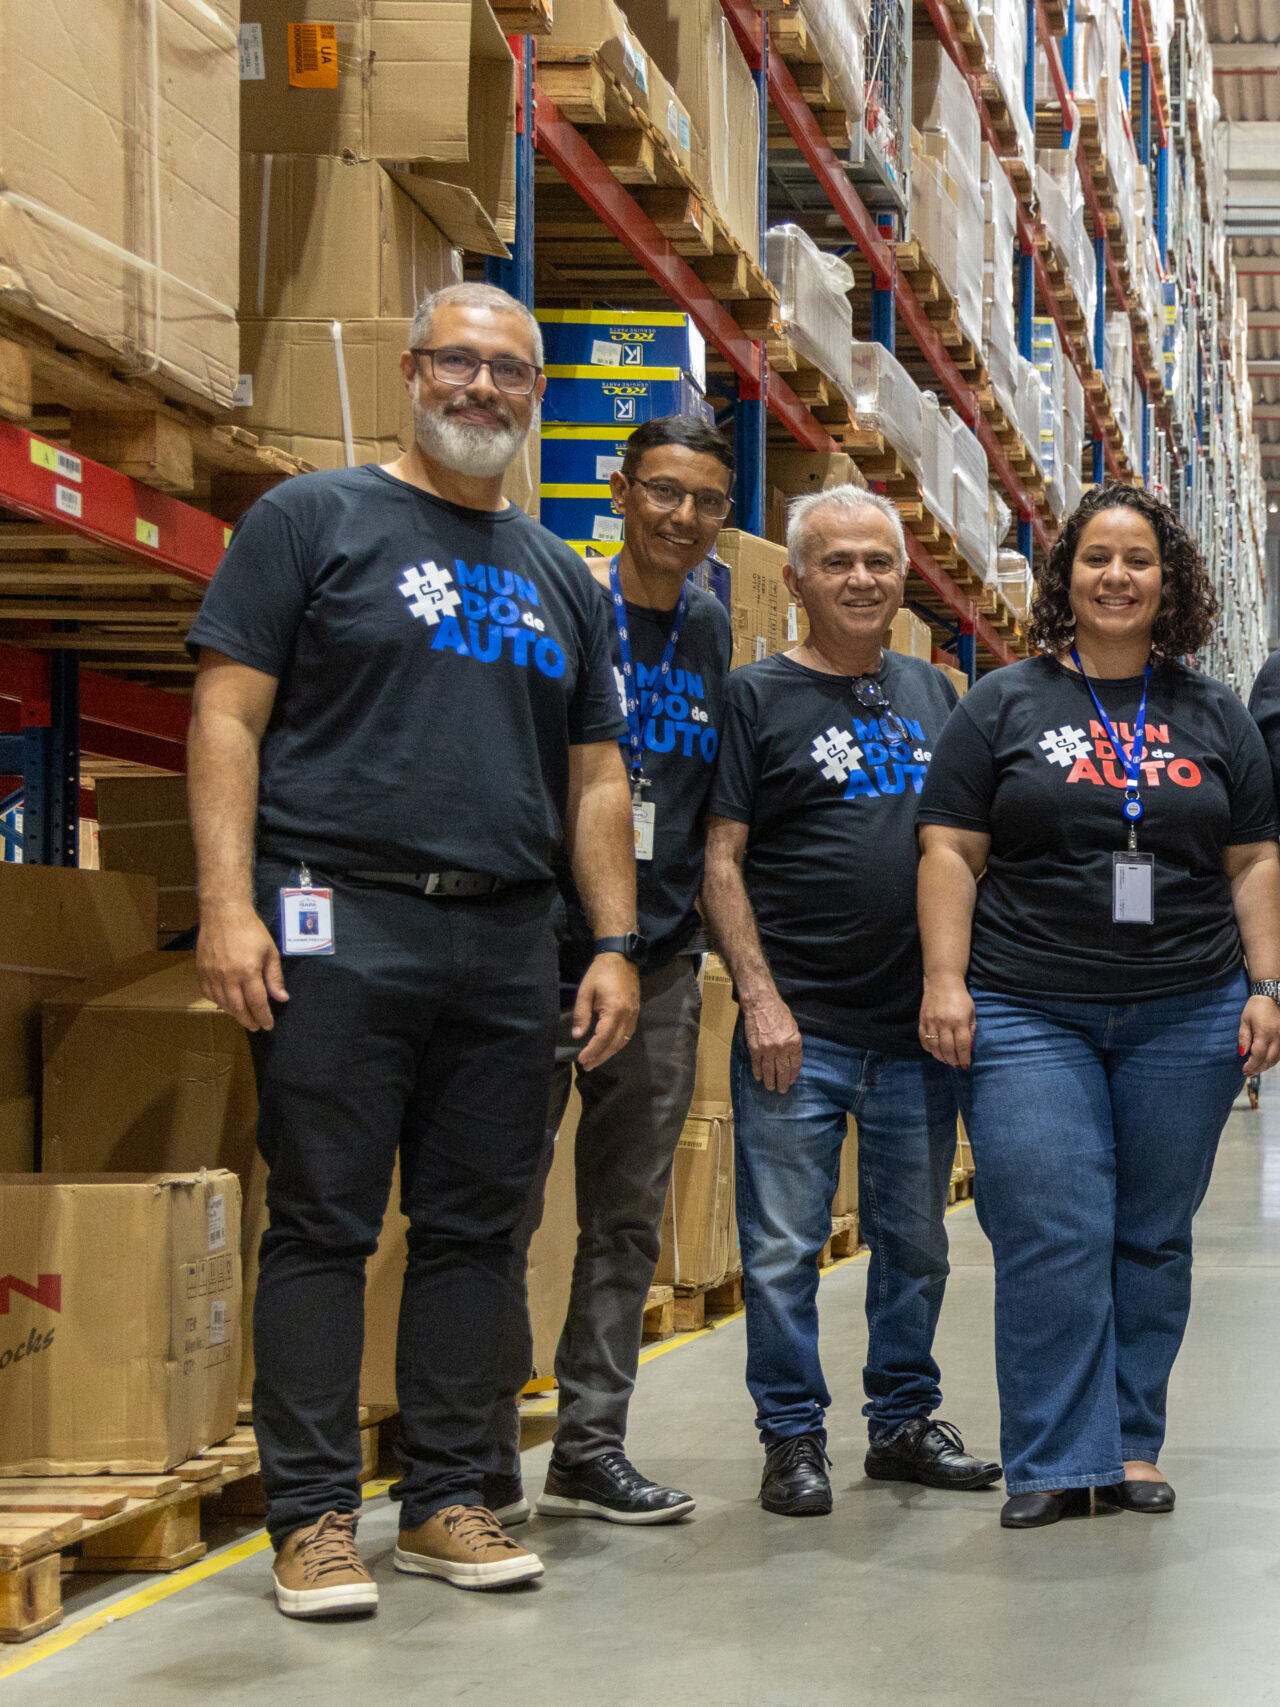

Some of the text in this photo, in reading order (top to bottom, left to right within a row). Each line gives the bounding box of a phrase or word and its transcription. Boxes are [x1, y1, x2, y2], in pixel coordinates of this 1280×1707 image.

[321, 46, 332, 64] UA
[609, 331, 656, 342] ROC
[602, 386, 648, 396] ROC
[455, 559, 540, 607] MUN
[462, 588, 545, 632] DO de
[431, 615, 566, 679] AUTO
[636, 662, 705, 699] MUN
[691, 706, 709, 723] de
[618, 716, 718, 764] UTO
[1089, 719, 1170, 744] MUN
[862, 742, 932, 766] DO de
[1094, 739, 1148, 761] DO
[843, 763, 928, 800] AUT
[1065, 758, 1202, 789] AUTO
